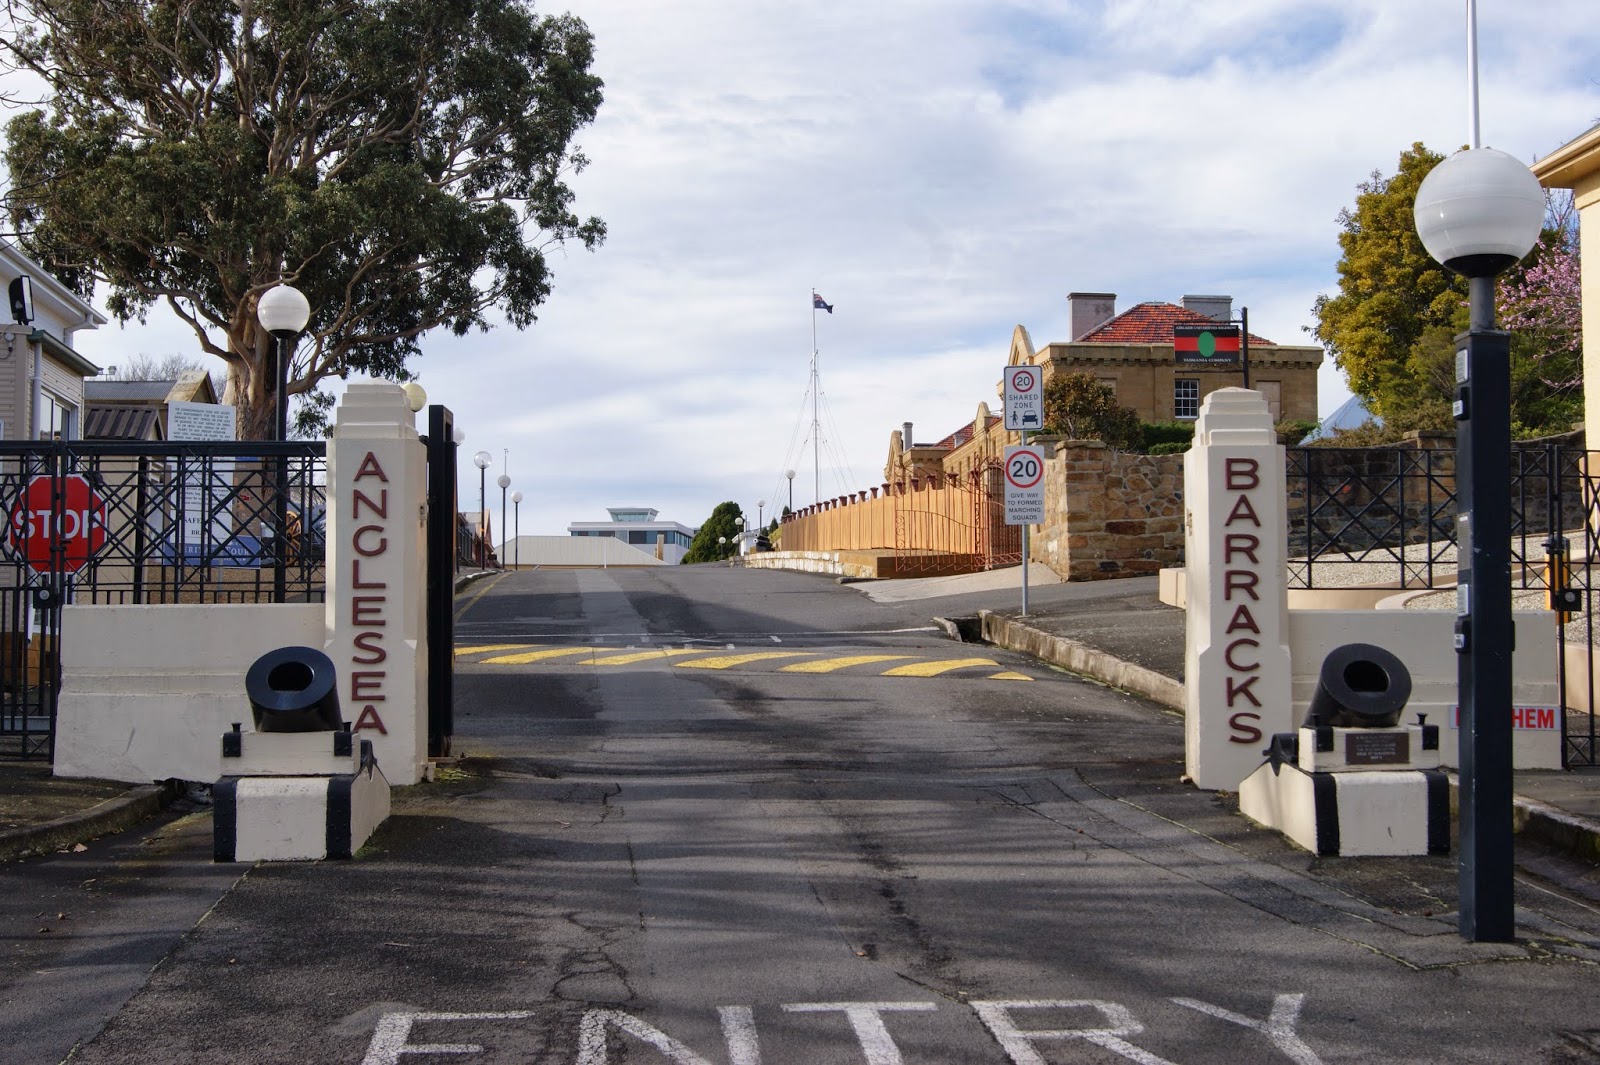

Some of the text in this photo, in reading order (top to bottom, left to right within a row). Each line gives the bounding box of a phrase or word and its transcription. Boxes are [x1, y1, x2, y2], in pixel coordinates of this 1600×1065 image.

[1016, 376, 1030, 386] 20
[1012, 460, 1037, 478] 20
[15, 509, 102, 539] STOP
[351, 451, 388, 735] ANGLESEA
[1224, 458, 1262, 744] BARRACKS
[363, 994, 1320, 1065] ENTRY
